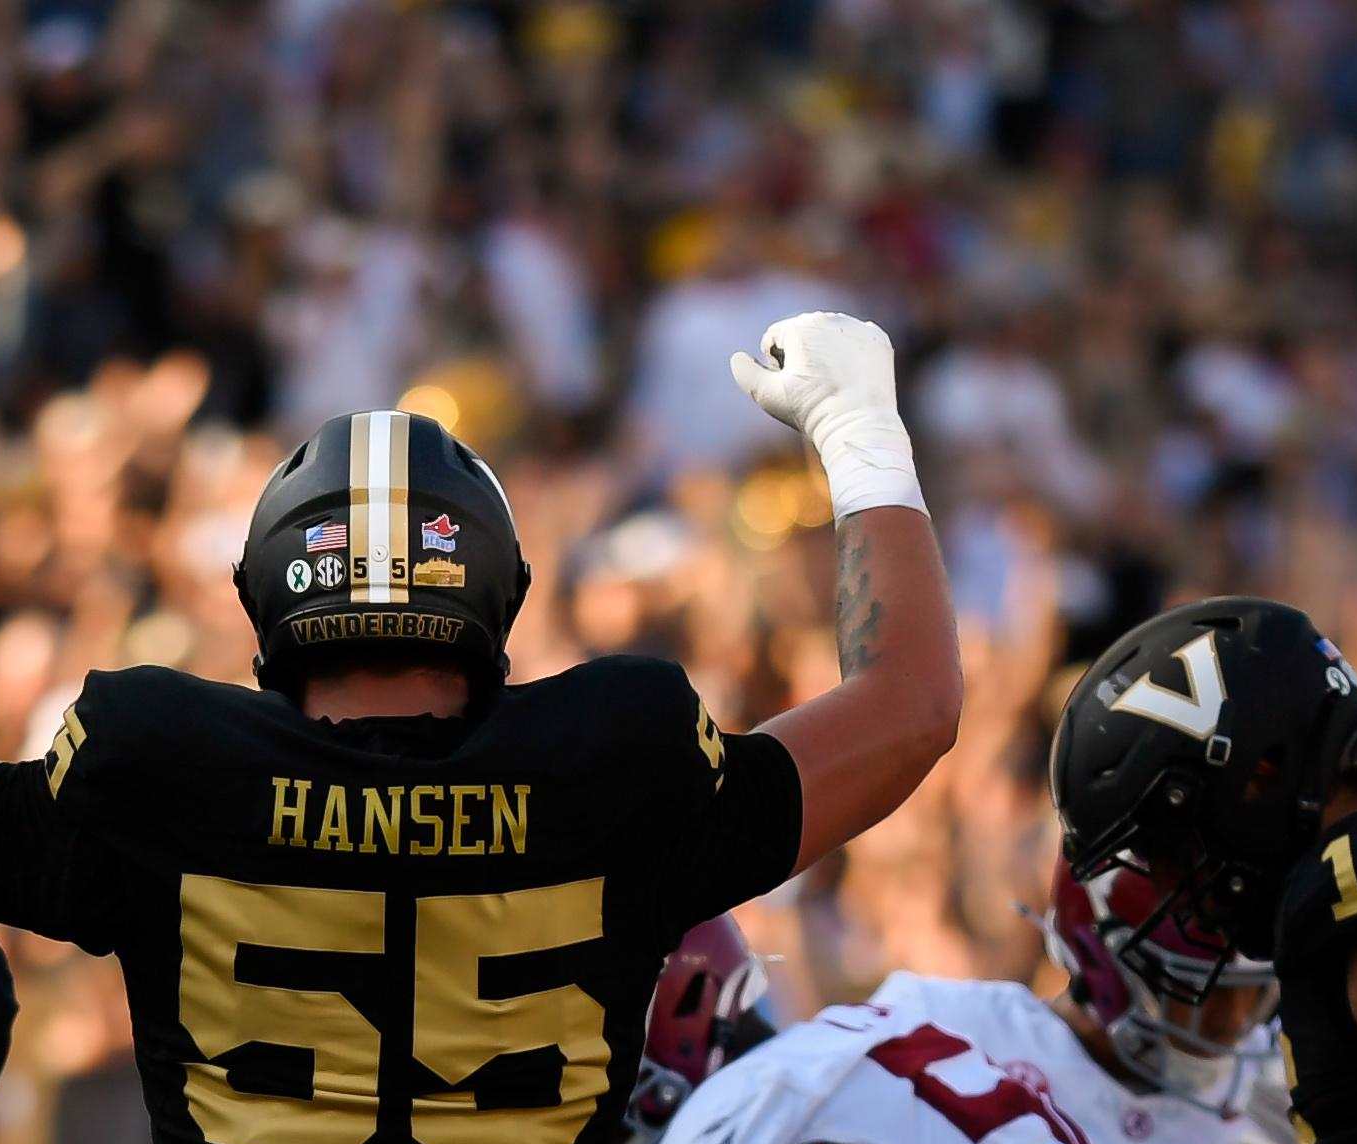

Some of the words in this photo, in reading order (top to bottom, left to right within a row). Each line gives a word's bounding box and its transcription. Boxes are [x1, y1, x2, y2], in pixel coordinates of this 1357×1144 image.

[315, 555, 345, 588] SEC
[292, 612, 466, 645] VANDERBILT
[1109, 631, 1227, 741] V
[267, 776, 531, 856] HANSEN
